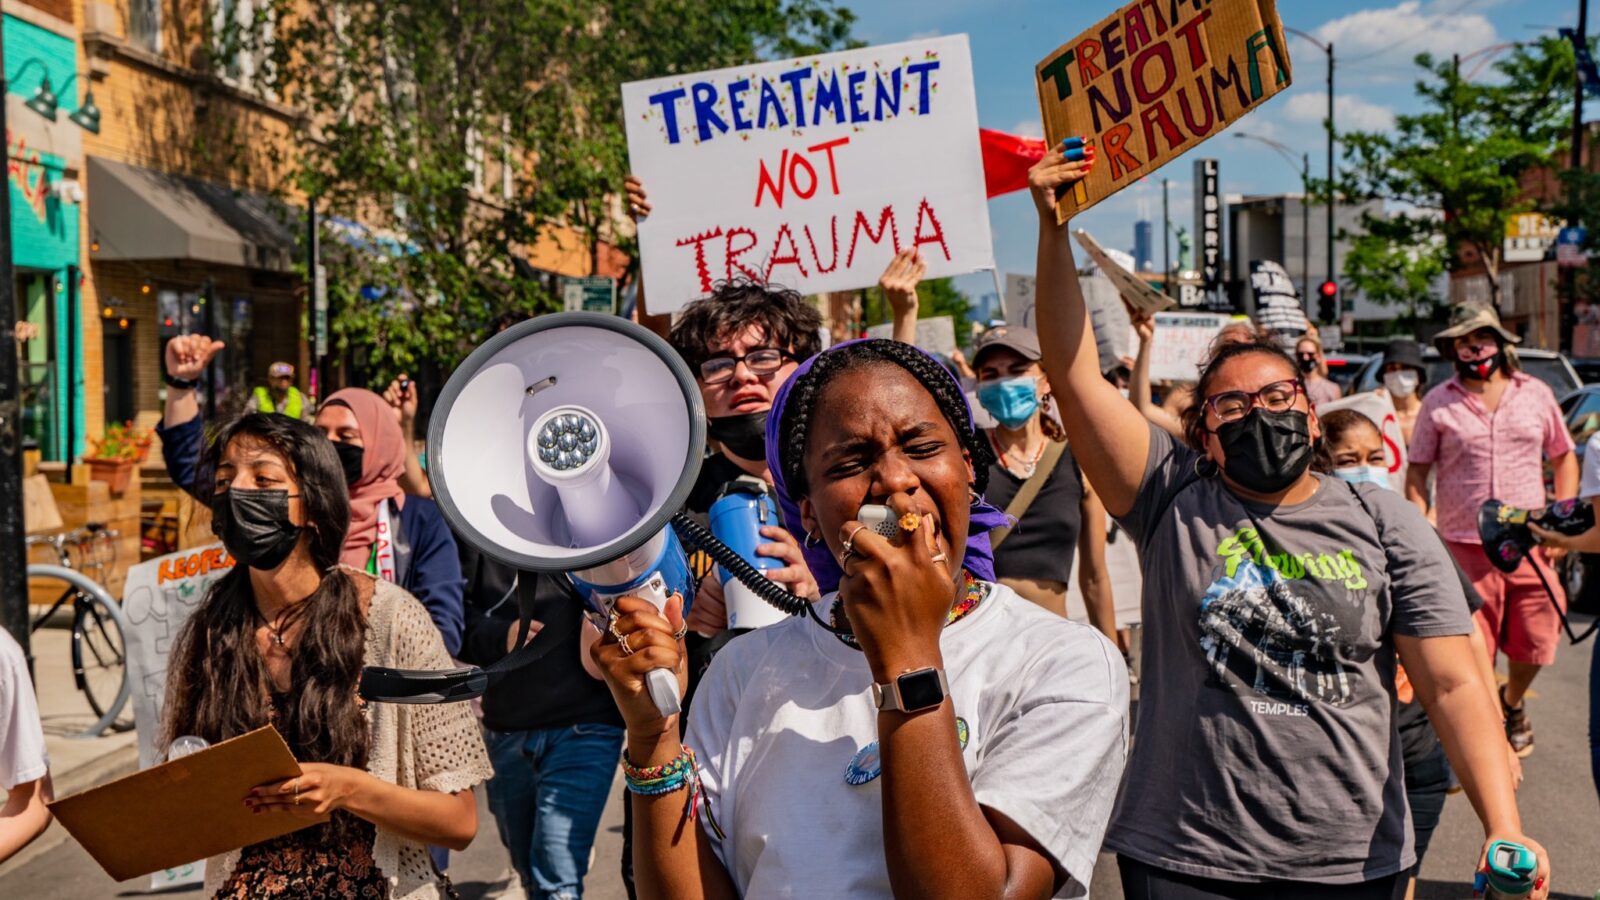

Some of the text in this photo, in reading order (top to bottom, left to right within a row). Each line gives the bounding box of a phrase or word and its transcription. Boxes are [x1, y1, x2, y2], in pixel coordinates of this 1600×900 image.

[648, 60, 941, 145] TREATMENT
[1086, 9, 1212, 133] NOT
[754, 136, 850, 209] NOT
[675, 197, 952, 293] TRAUMA
[1204, 159, 1218, 281] LIBERTY
[1250, 700, 1309, 717] TEMPLES
